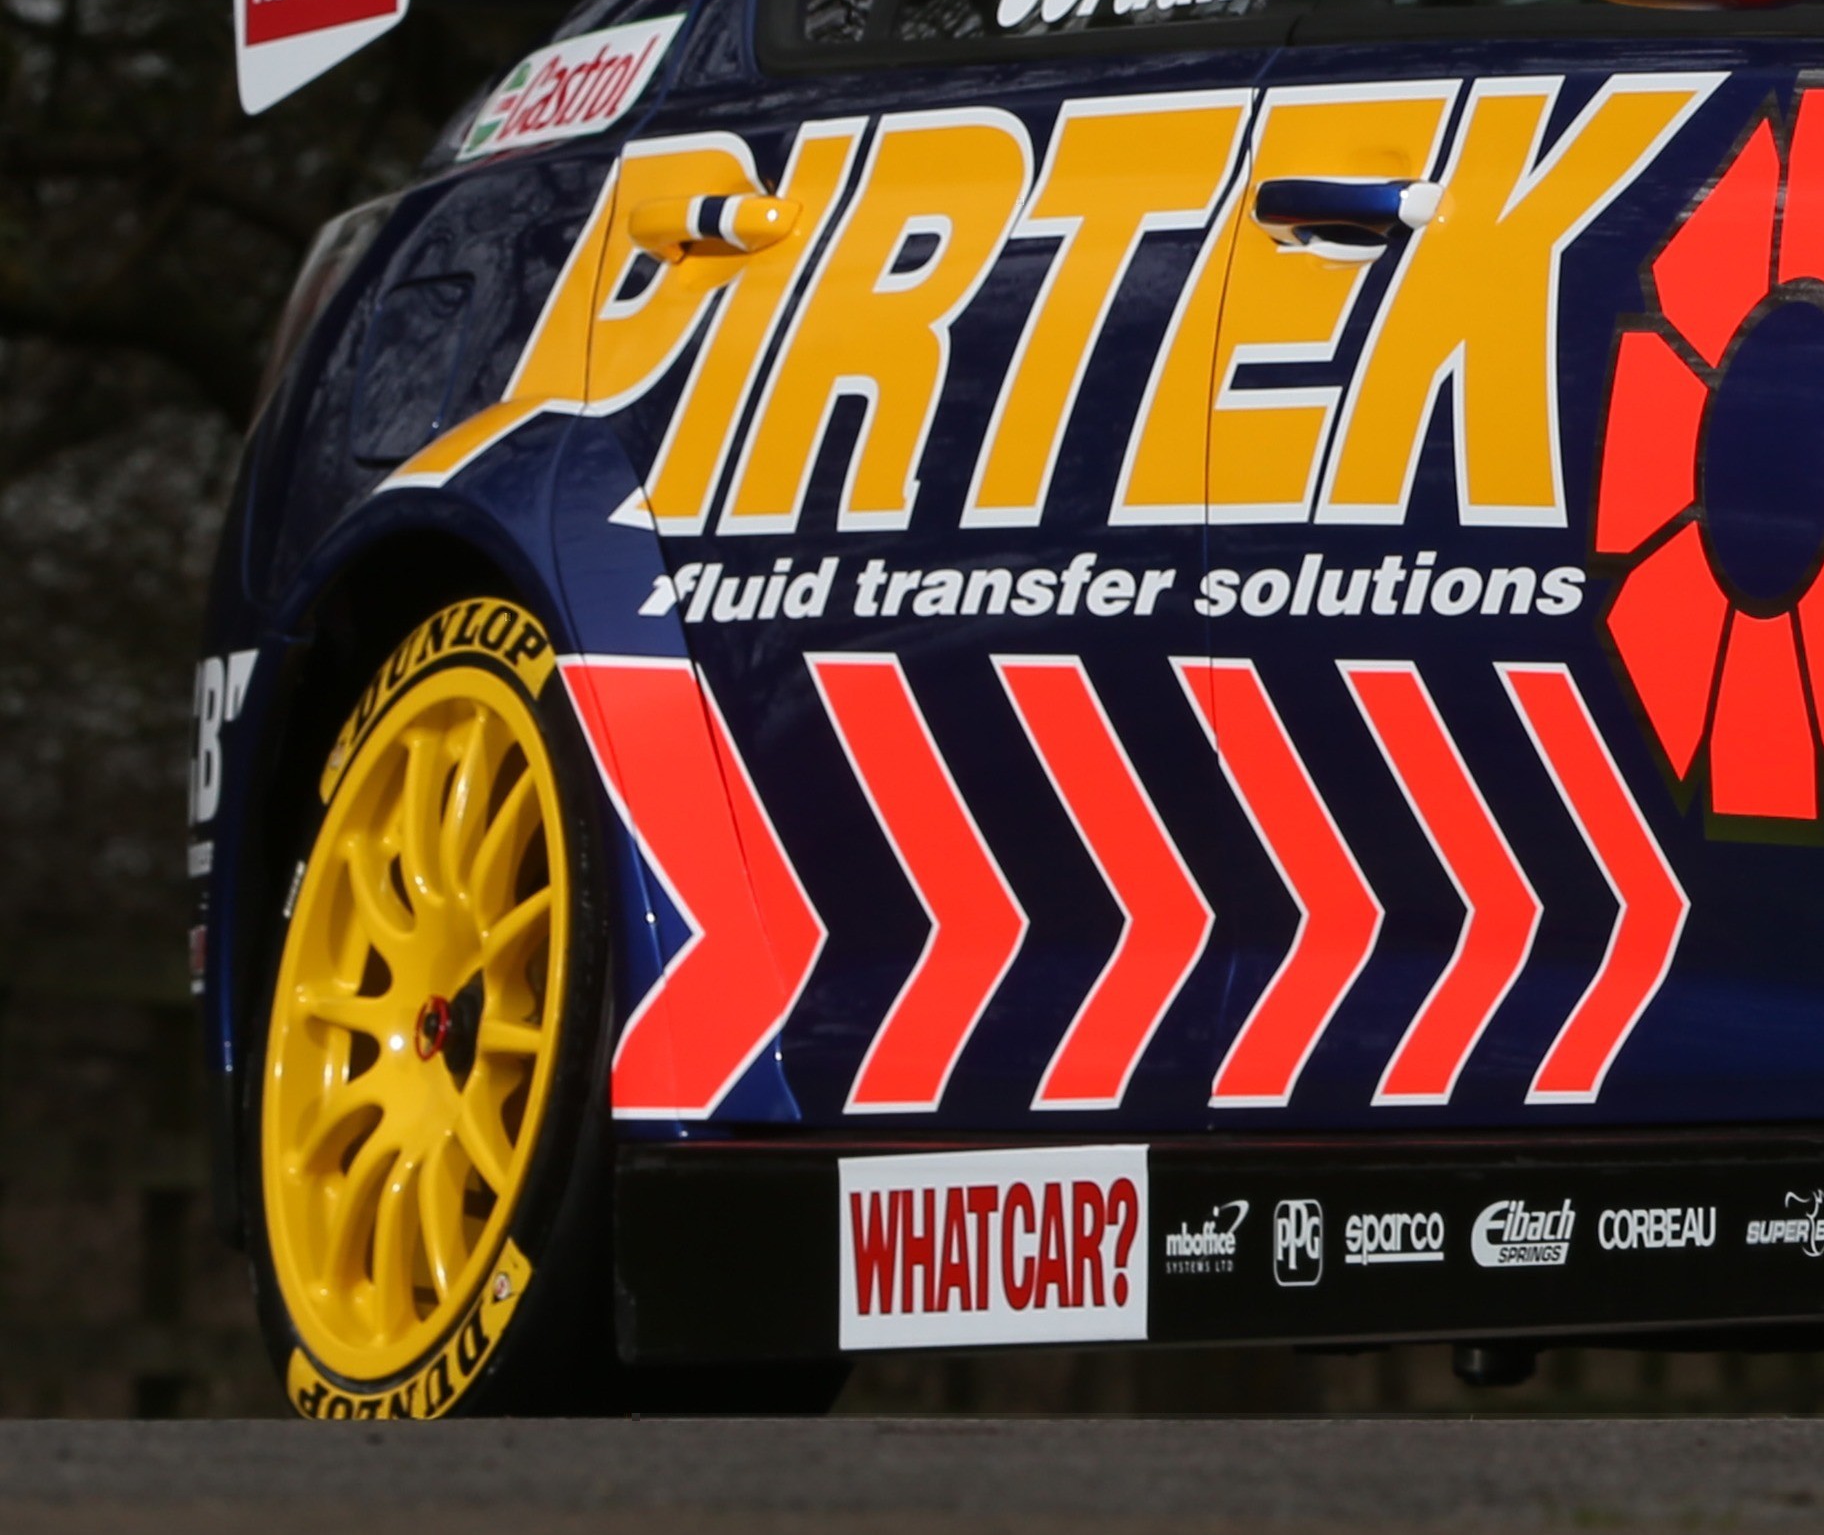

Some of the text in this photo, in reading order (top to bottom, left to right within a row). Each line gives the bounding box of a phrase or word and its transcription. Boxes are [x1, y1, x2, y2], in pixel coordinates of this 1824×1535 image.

[499, 33, 660, 141] Castrol
[372, 71, 1732, 536] PIRTEK
[637, 551, 1587, 623] fluid transfer solutions
[348, 601, 550, 734] DUNLOP
[1344, 1212, 1445, 1266] sparco
[1471, 1198, 1577, 1253] Eibach
[1598, 1206, 1717, 1251] CORBEAU
[1745, 1219, 1810, 1245] SUPER
[1497, 1245, 1562, 1264] SPRINGS
